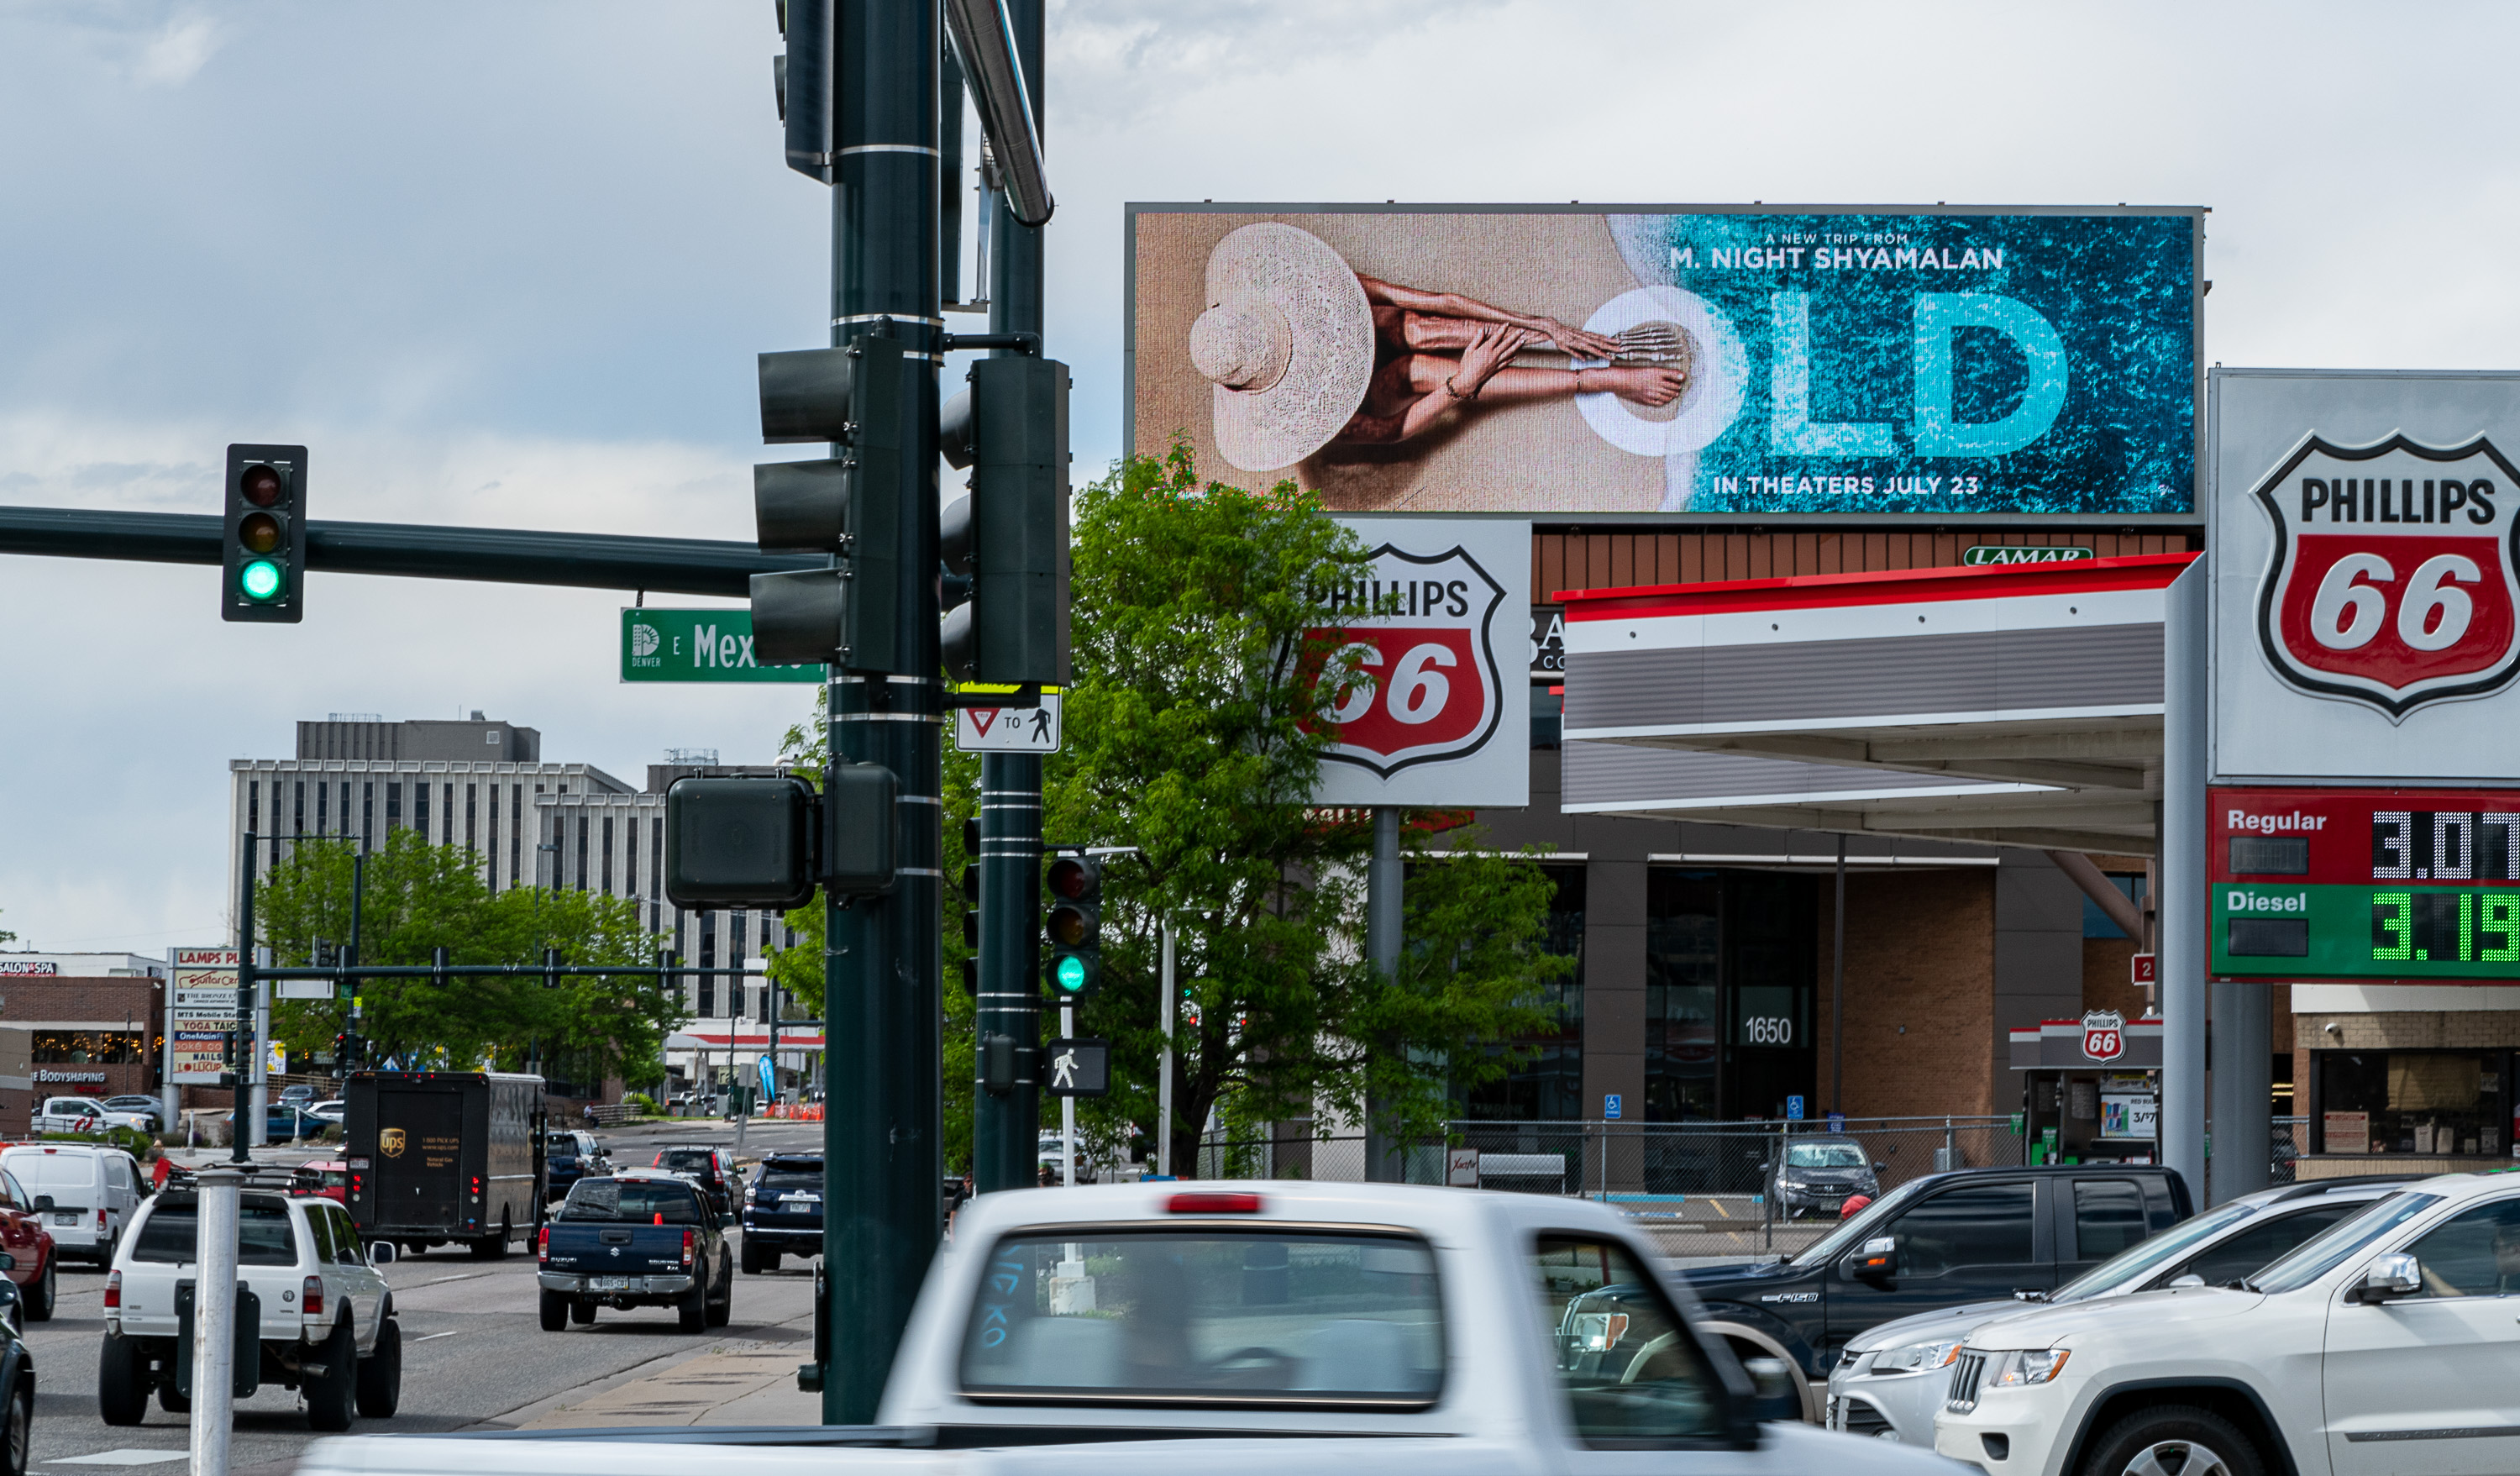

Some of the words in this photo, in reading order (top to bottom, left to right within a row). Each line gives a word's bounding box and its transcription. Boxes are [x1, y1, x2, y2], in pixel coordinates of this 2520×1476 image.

[1765, 234, 1775, 244] A
[1782, 234, 1817, 244] NEW
[1824, 234, 1858, 244] TRIP
[1864, 234, 1908, 244] FROM
[1671, 247, 1700, 269] M.
[1711, 247, 1805, 269] NIGHT
[1814, 247, 2003, 269] SHYAMALAN
[1574, 285, 2069, 457] OLD
[1713, 476, 1739, 494] IN
[1746, 476, 1874, 494] THEATERS
[1882, 476, 1942, 494] JULY
[1950, 476, 1978, 494] 23
[2302, 478, 2495, 525] PHILLIPS
[1975, 549, 2079, 565] LAMAR
[2310, 553, 2481, 653] 66
[674, 636, 680, 654] E
[694, 624, 802, 669] Mex
[633, 658, 660, 667] DENVER
[1314, 643, 1457, 724] 66
[1005, 717, 1021, 728] TO
[2228, 810, 2327, 834] Regular
[2372, 812, 2520, 880] 3.07
[2228, 891, 2306, 911] Diesel
[2372, 892, 2520, 961] 3.19
[179, 952, 221, 964] LAMPS
[2142, 962, 2152, 977] 2
[183, 1022, 211, 1030] YOGA
[1746, 1016, 1792, 1044] 1650
[2087, 1018, 2118, 1028] PHILLIPS
[2089, 1032, 2116, 1053] 66
[381, 1137, 404, 1153] ups
